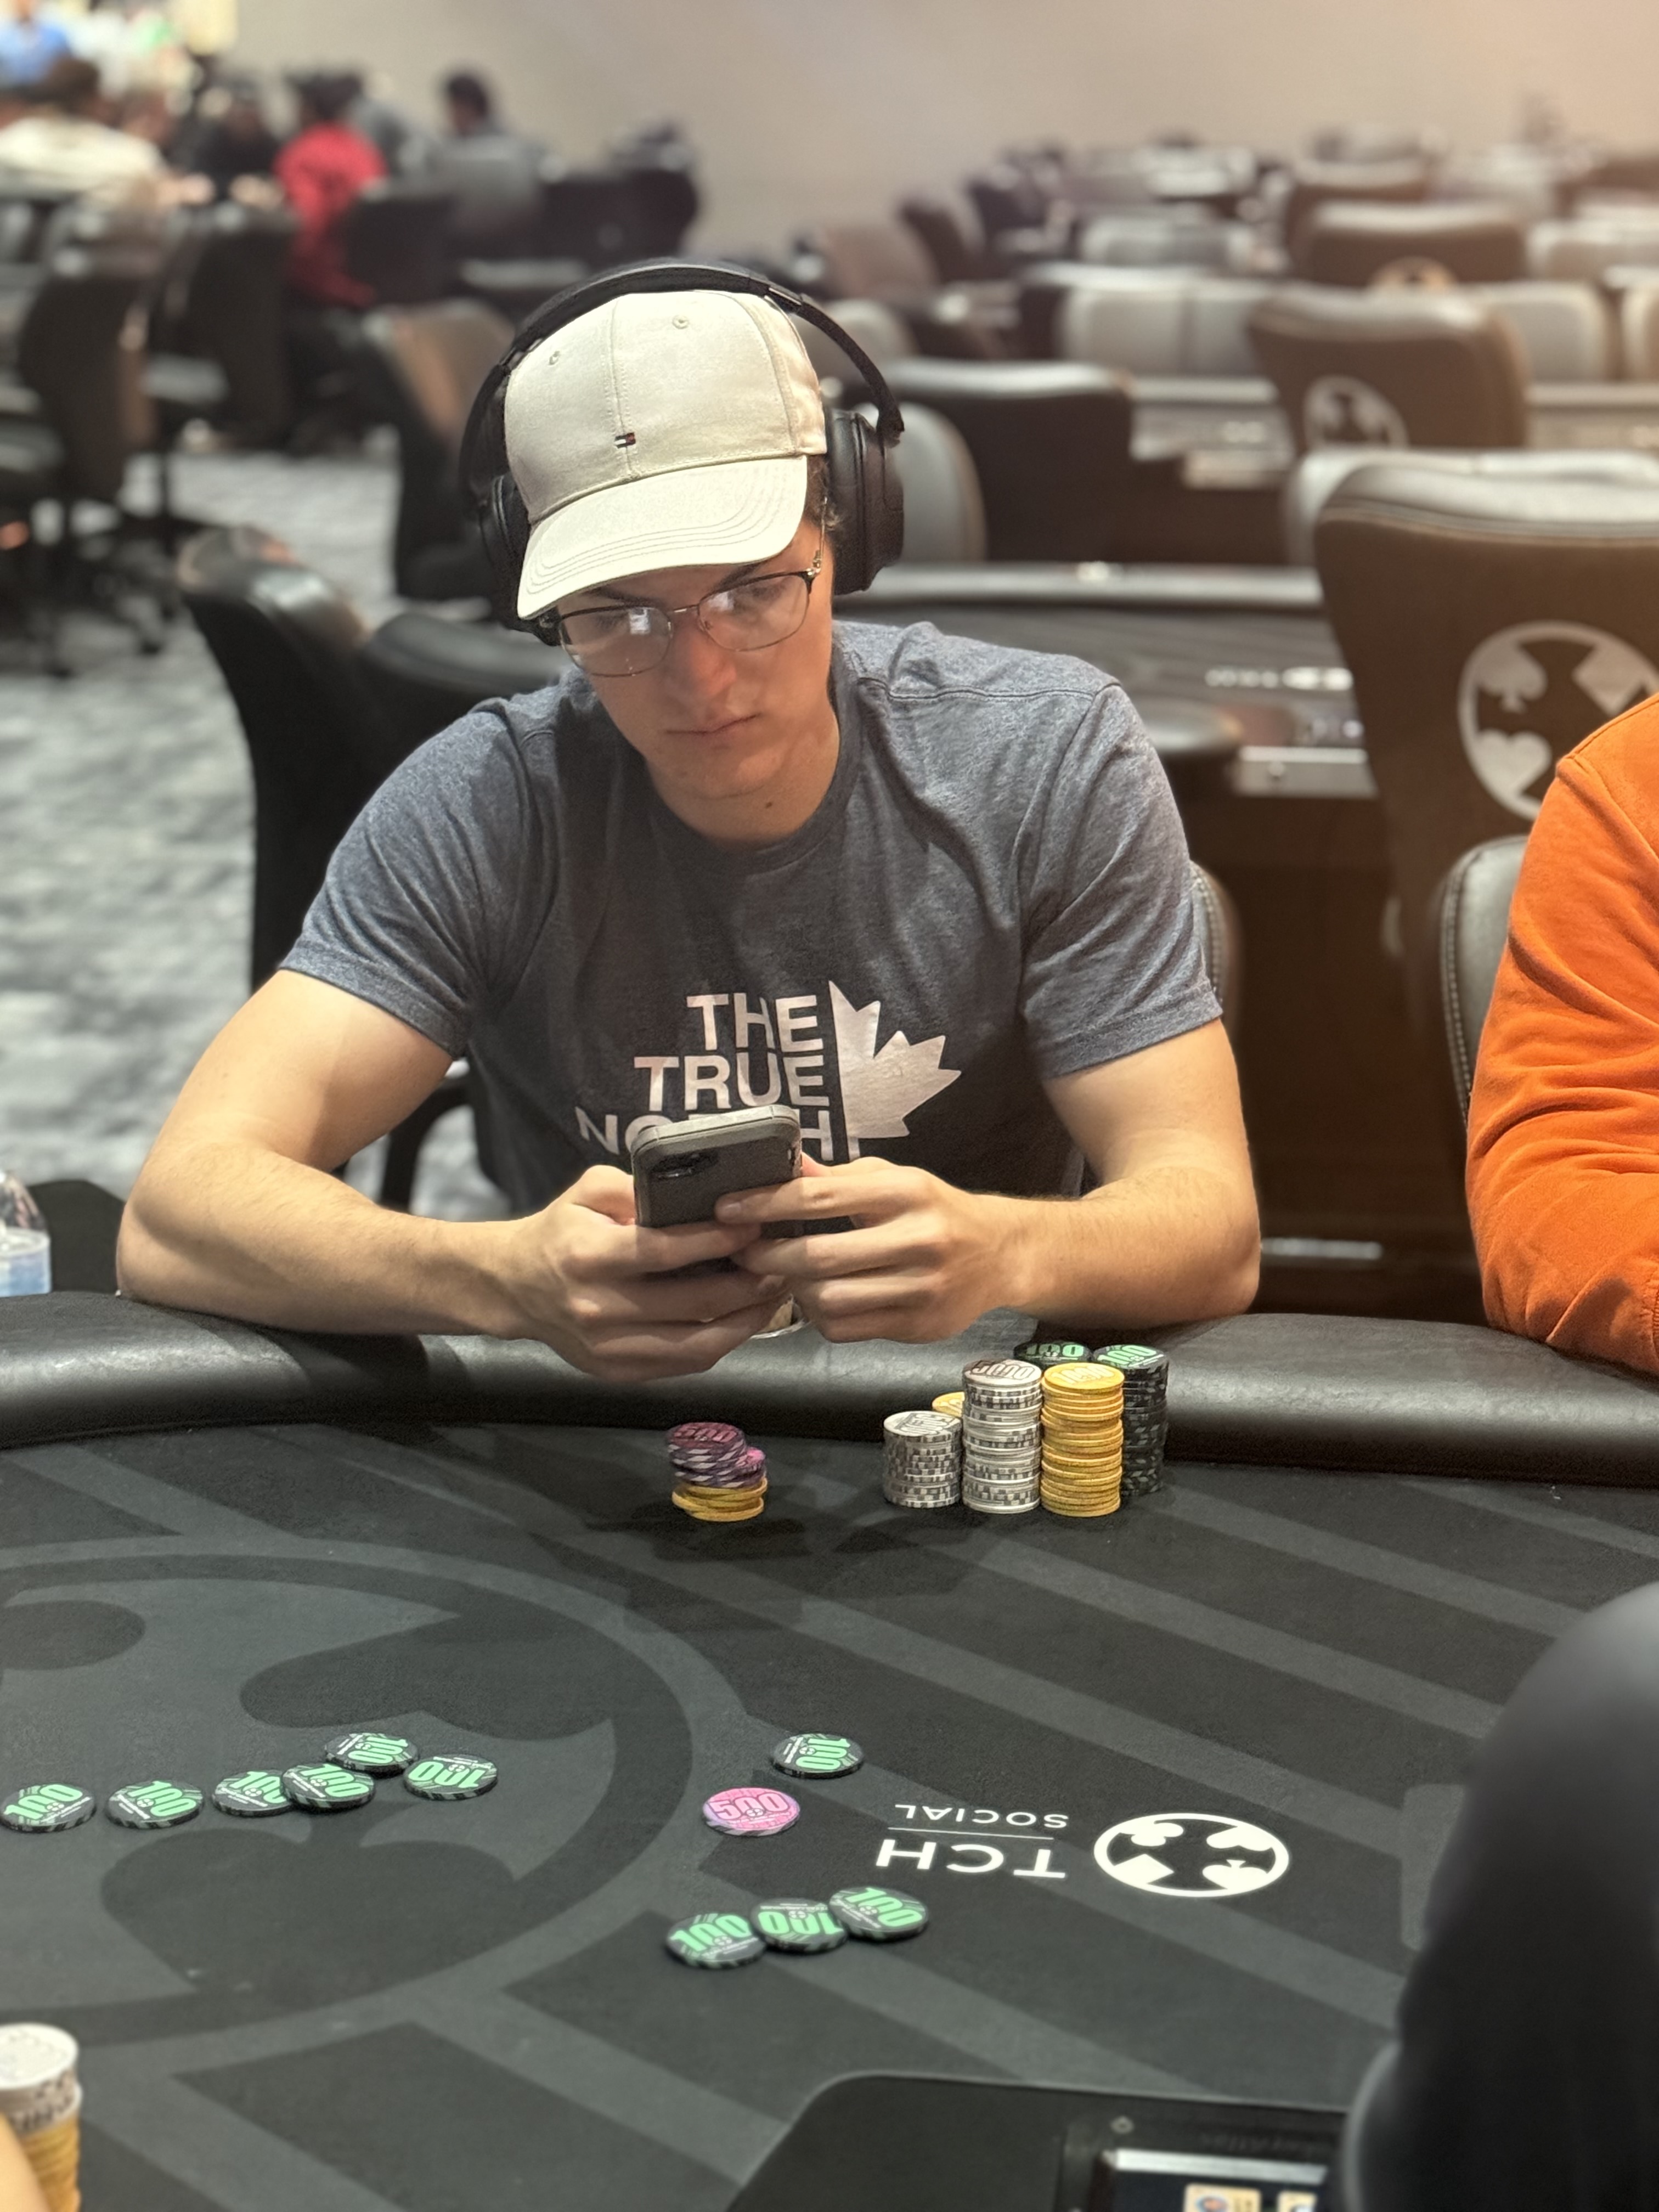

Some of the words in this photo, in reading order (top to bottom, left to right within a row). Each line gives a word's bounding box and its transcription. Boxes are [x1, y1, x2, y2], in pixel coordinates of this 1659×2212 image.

[686, 992, 823, 1052] THE
[634, 1052, 830, 1111] TRUE
[575, 1106, 833, 1161] NOH
[1026, 1343, 1084, 1357] 100
[1098, 1344, 1156, 1365] 100
[347, 1736, 408, 1764] 100
[795, 1738, 851, 1770] 100
[229, 1771, 287, 1804] 100
[300, 1763, 369, 1798] 100
[408, 1760, 486, 1788] 100
[3, 1784, 83, 1820] 100
[127, 1781, 196, 1817] 100
[709, 1793, 788, 1820] 500
[895, 1804, 1069, 1829] SOCIAL
[876, 1839, 1066, 1879] TCH
[758, 1911, 844, 1935] 100
[844, 1887, 923, 1927] 100
[669, 1915, 753, 1952] 100
